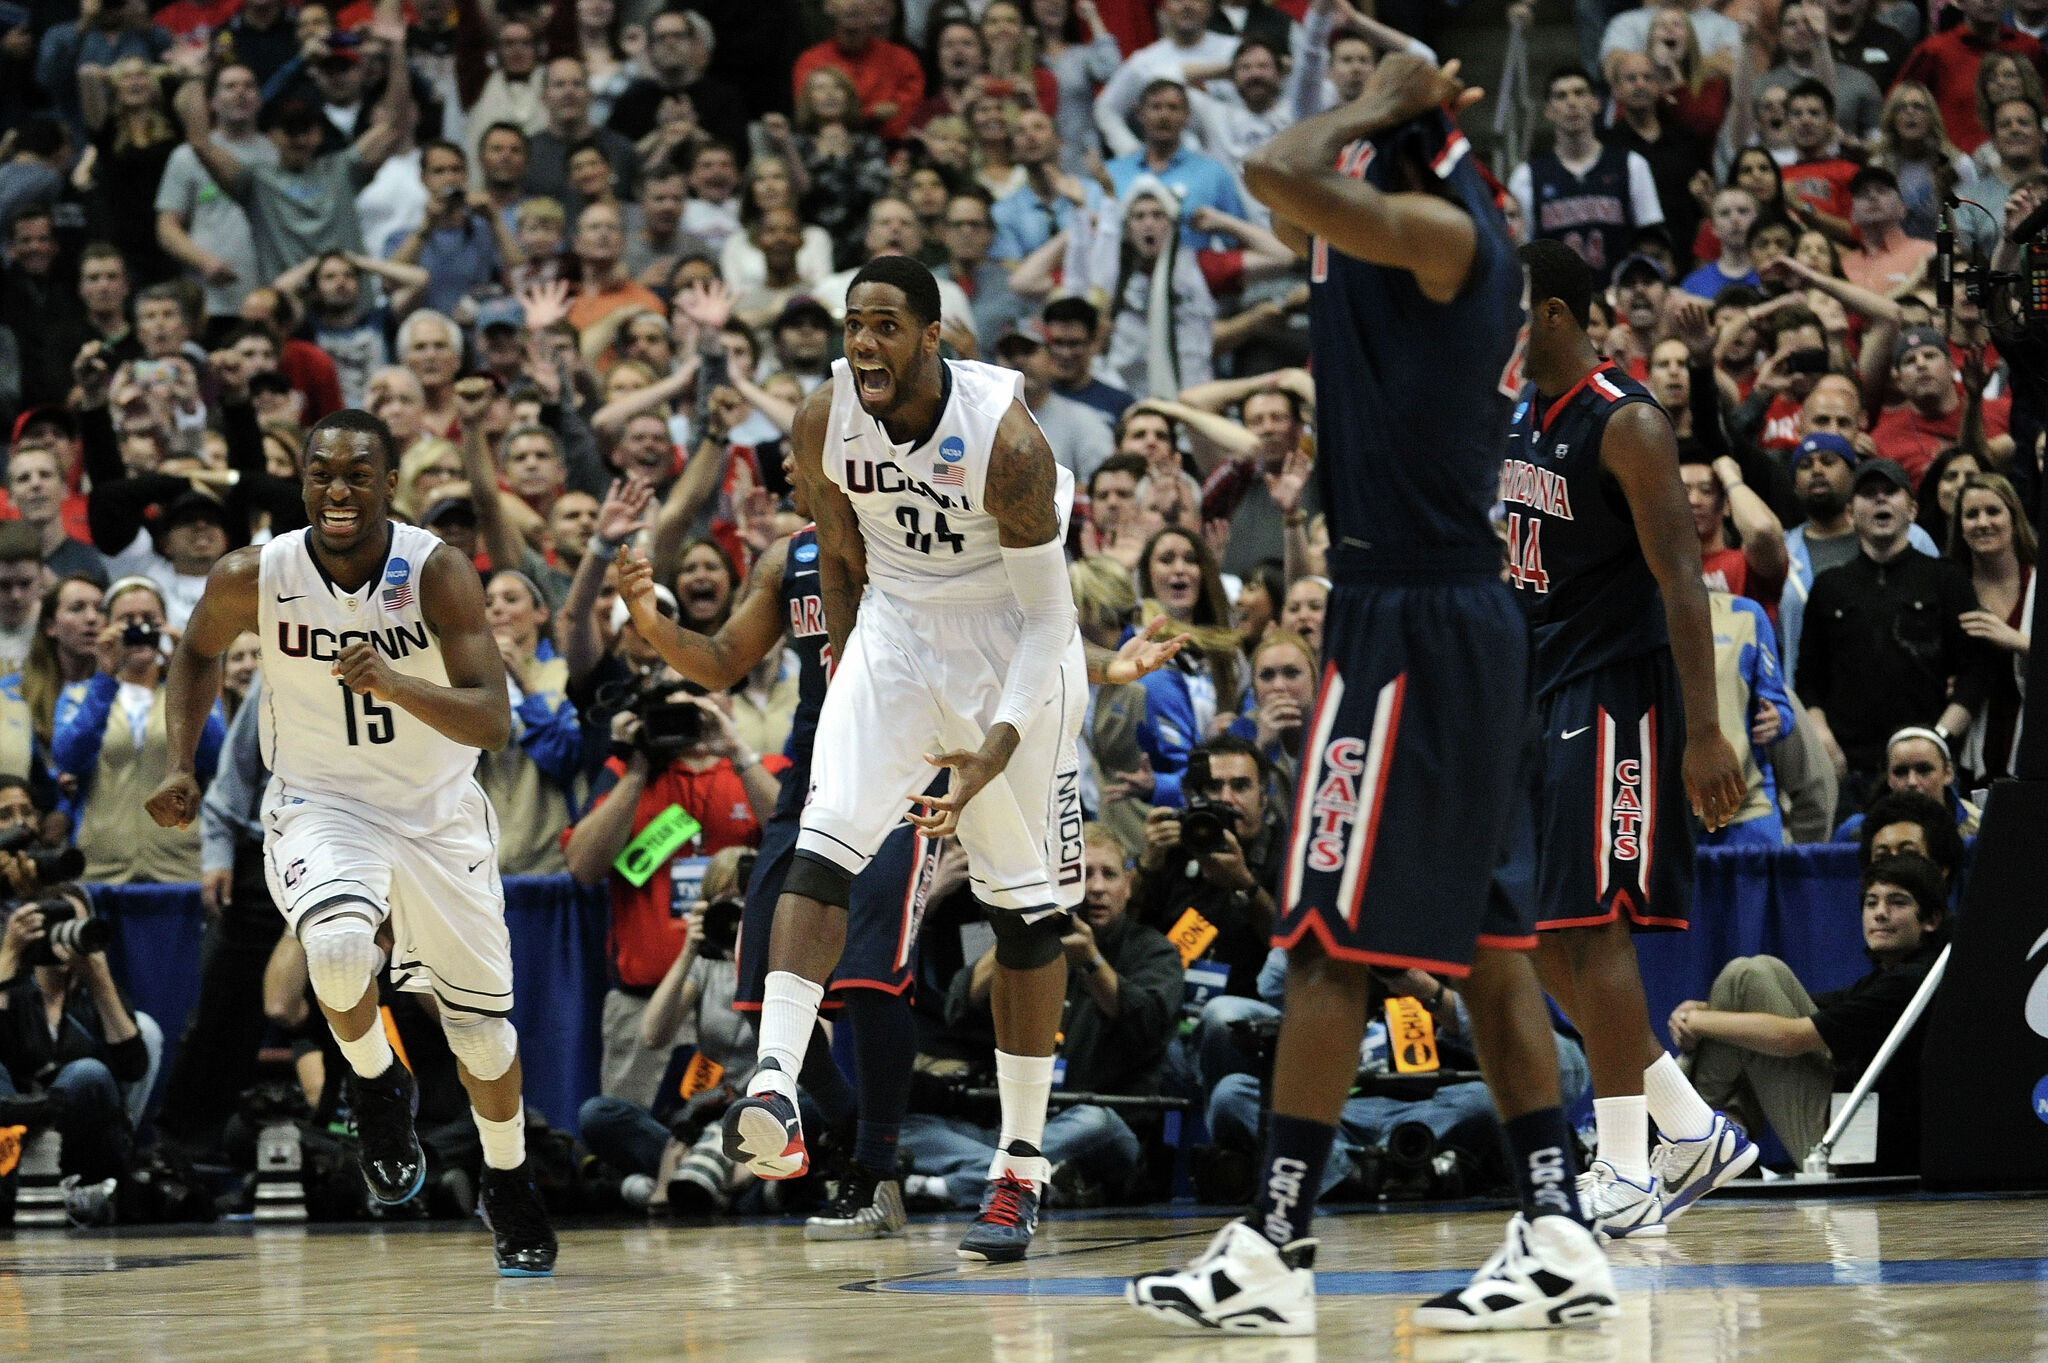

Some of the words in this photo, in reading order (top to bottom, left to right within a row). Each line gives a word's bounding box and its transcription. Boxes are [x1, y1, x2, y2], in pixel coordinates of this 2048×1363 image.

[790, 595, 828, 638] AR
[338, 677, 394, 746] 15
[1057, 770, 1082, 886] UCONN
[1307, 737, 1365, 872] CATS
[1612, 759, 1643, 860] CATS
